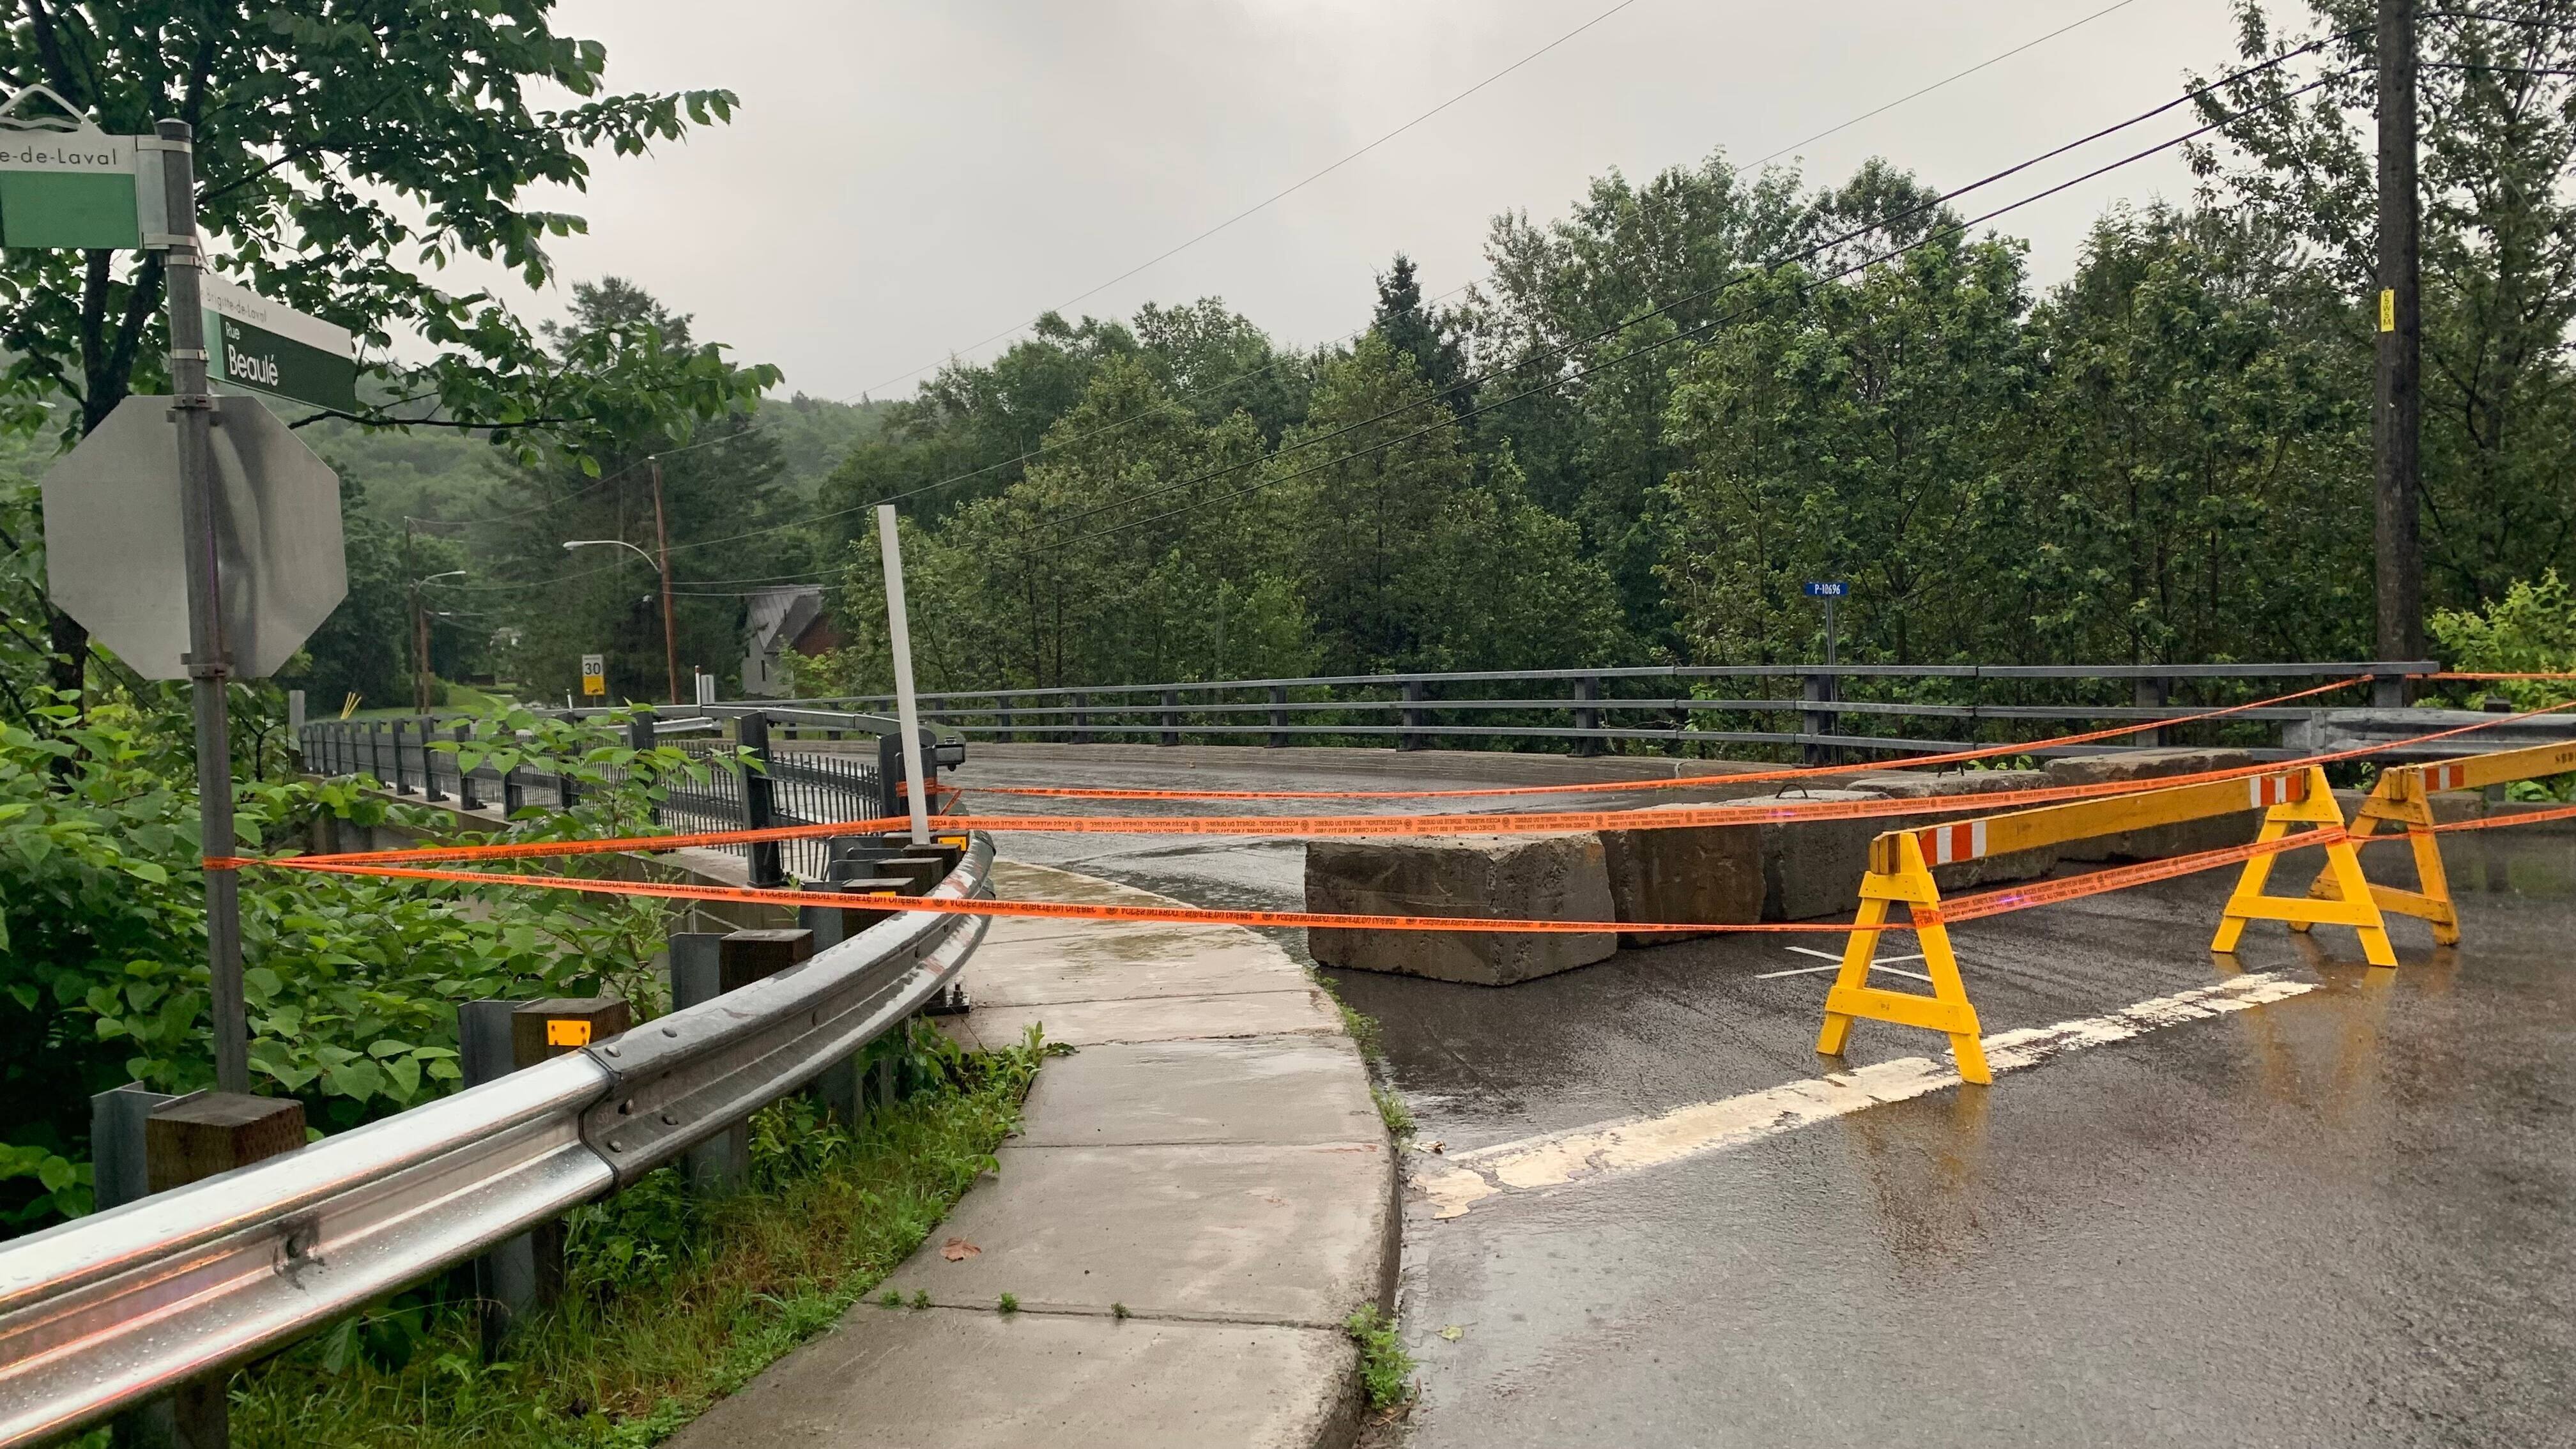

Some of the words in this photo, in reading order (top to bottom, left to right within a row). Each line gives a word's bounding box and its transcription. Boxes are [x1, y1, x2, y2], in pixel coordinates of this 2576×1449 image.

[226, 321, 240, 340] Rue
[228, 344, 279, 387] Beaulé
[585, 663, 601, 675] 30
